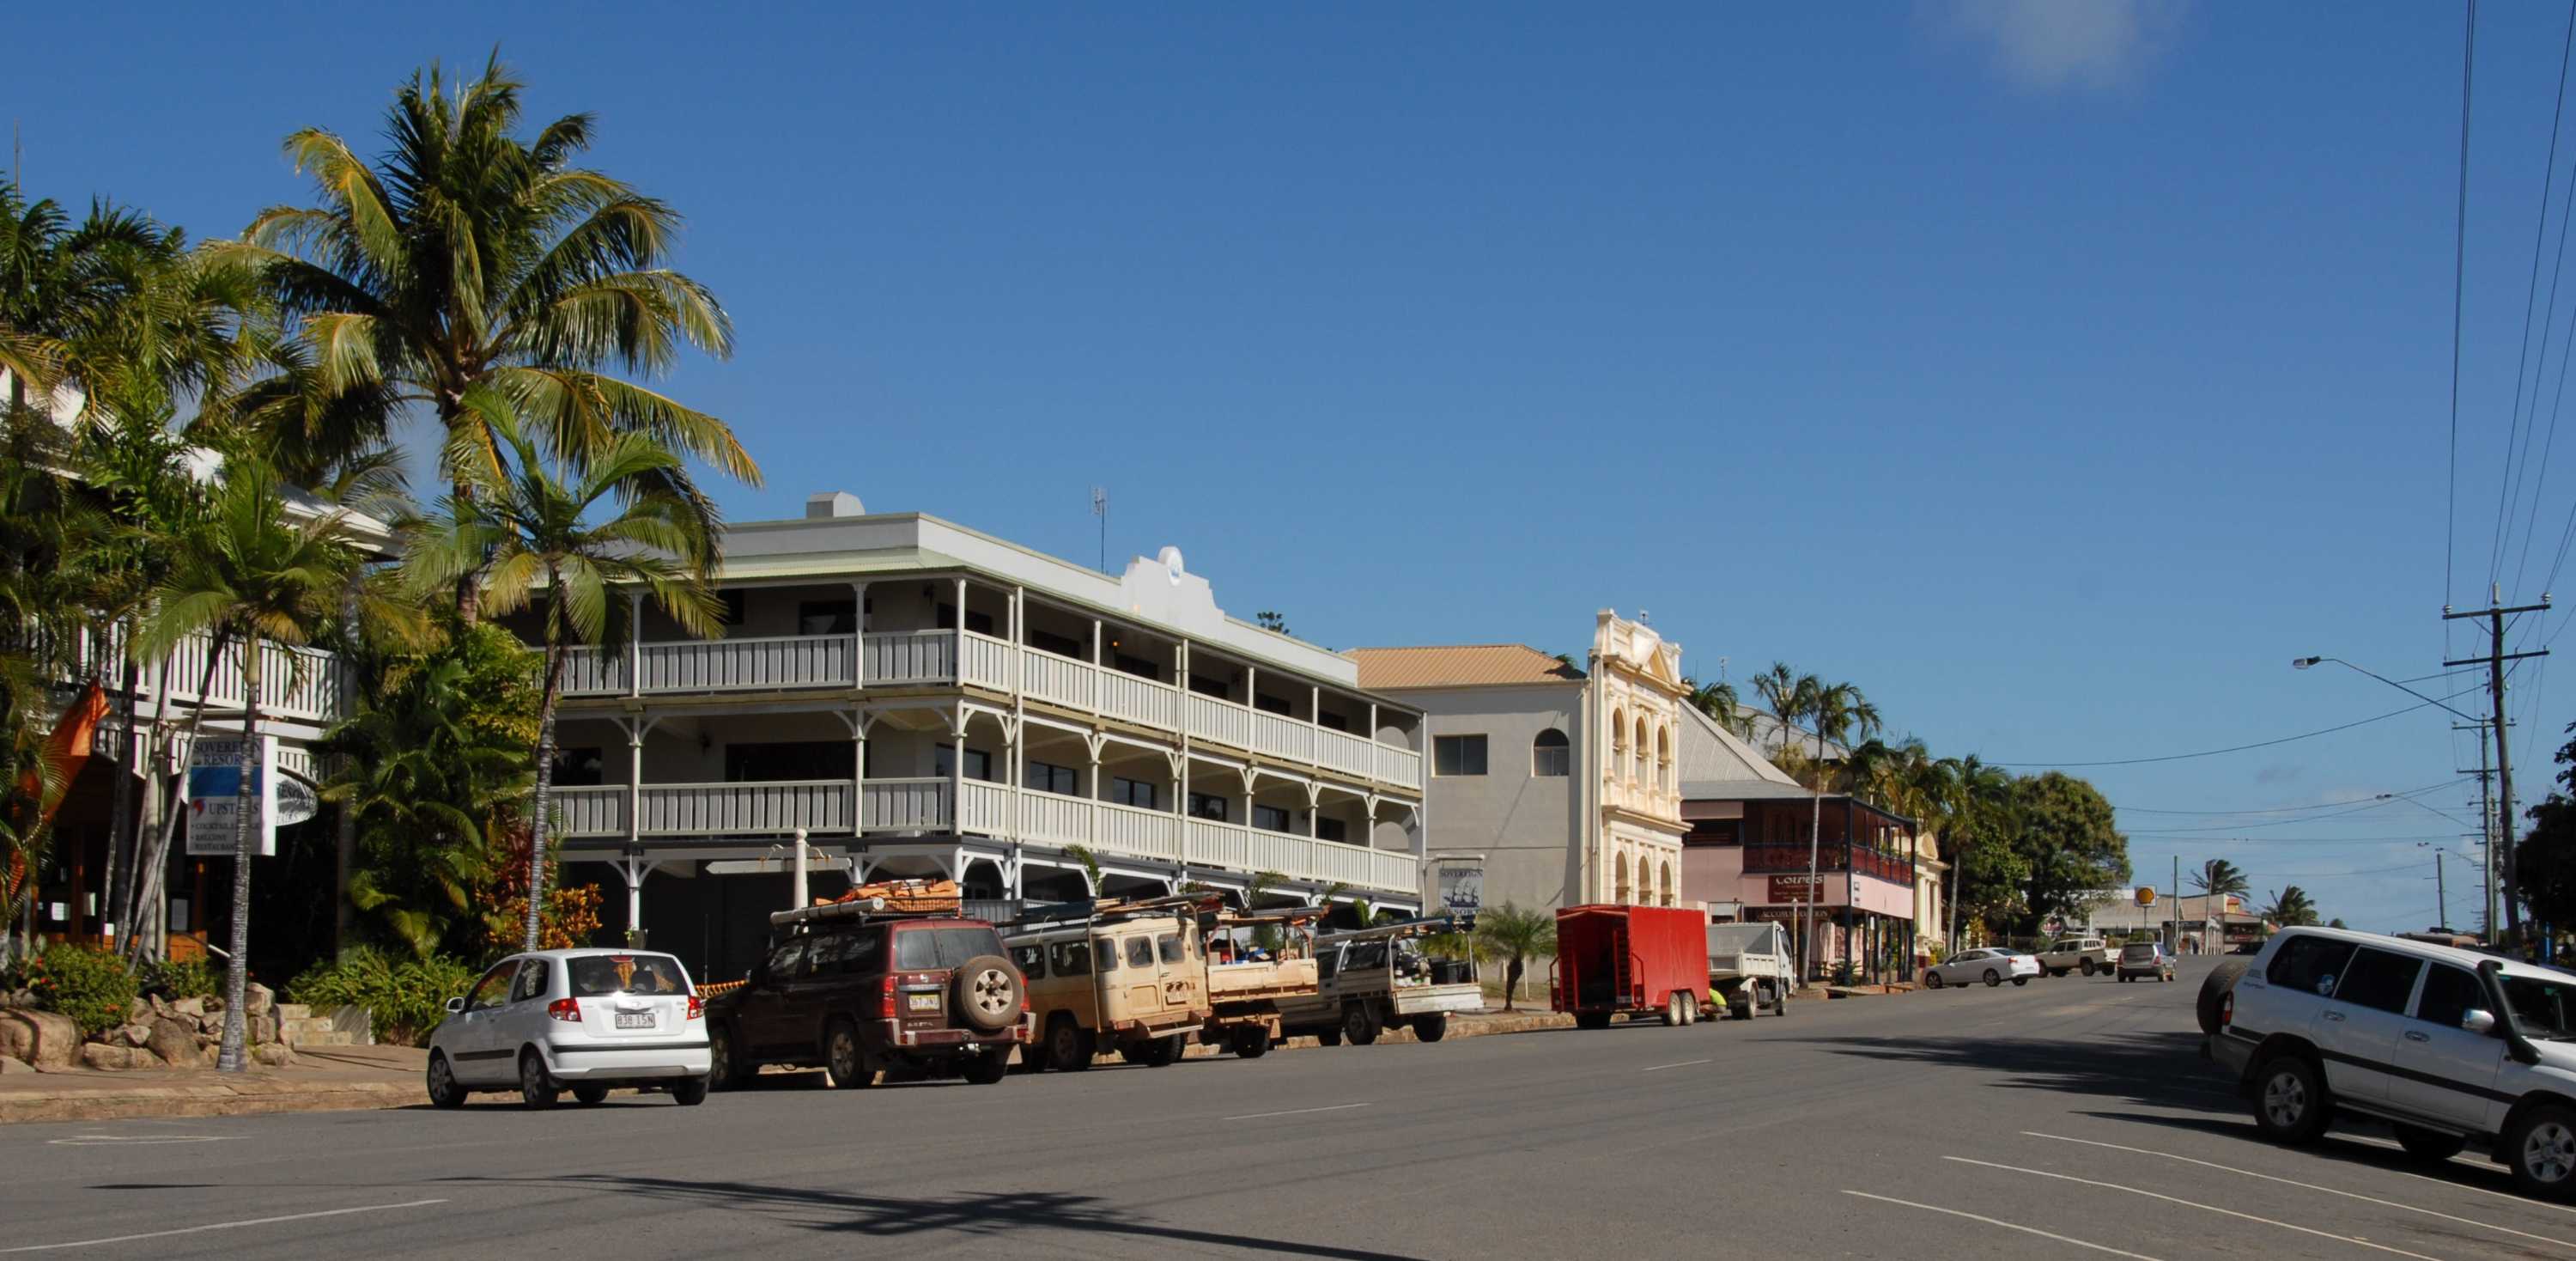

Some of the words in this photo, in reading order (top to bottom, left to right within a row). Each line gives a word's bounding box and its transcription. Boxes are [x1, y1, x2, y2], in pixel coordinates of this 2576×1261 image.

[194, 740, 261, 753] SOVEREN
[204, 754, 245, 765] RESOR
[209, 803, 260, 815] UPSTS
